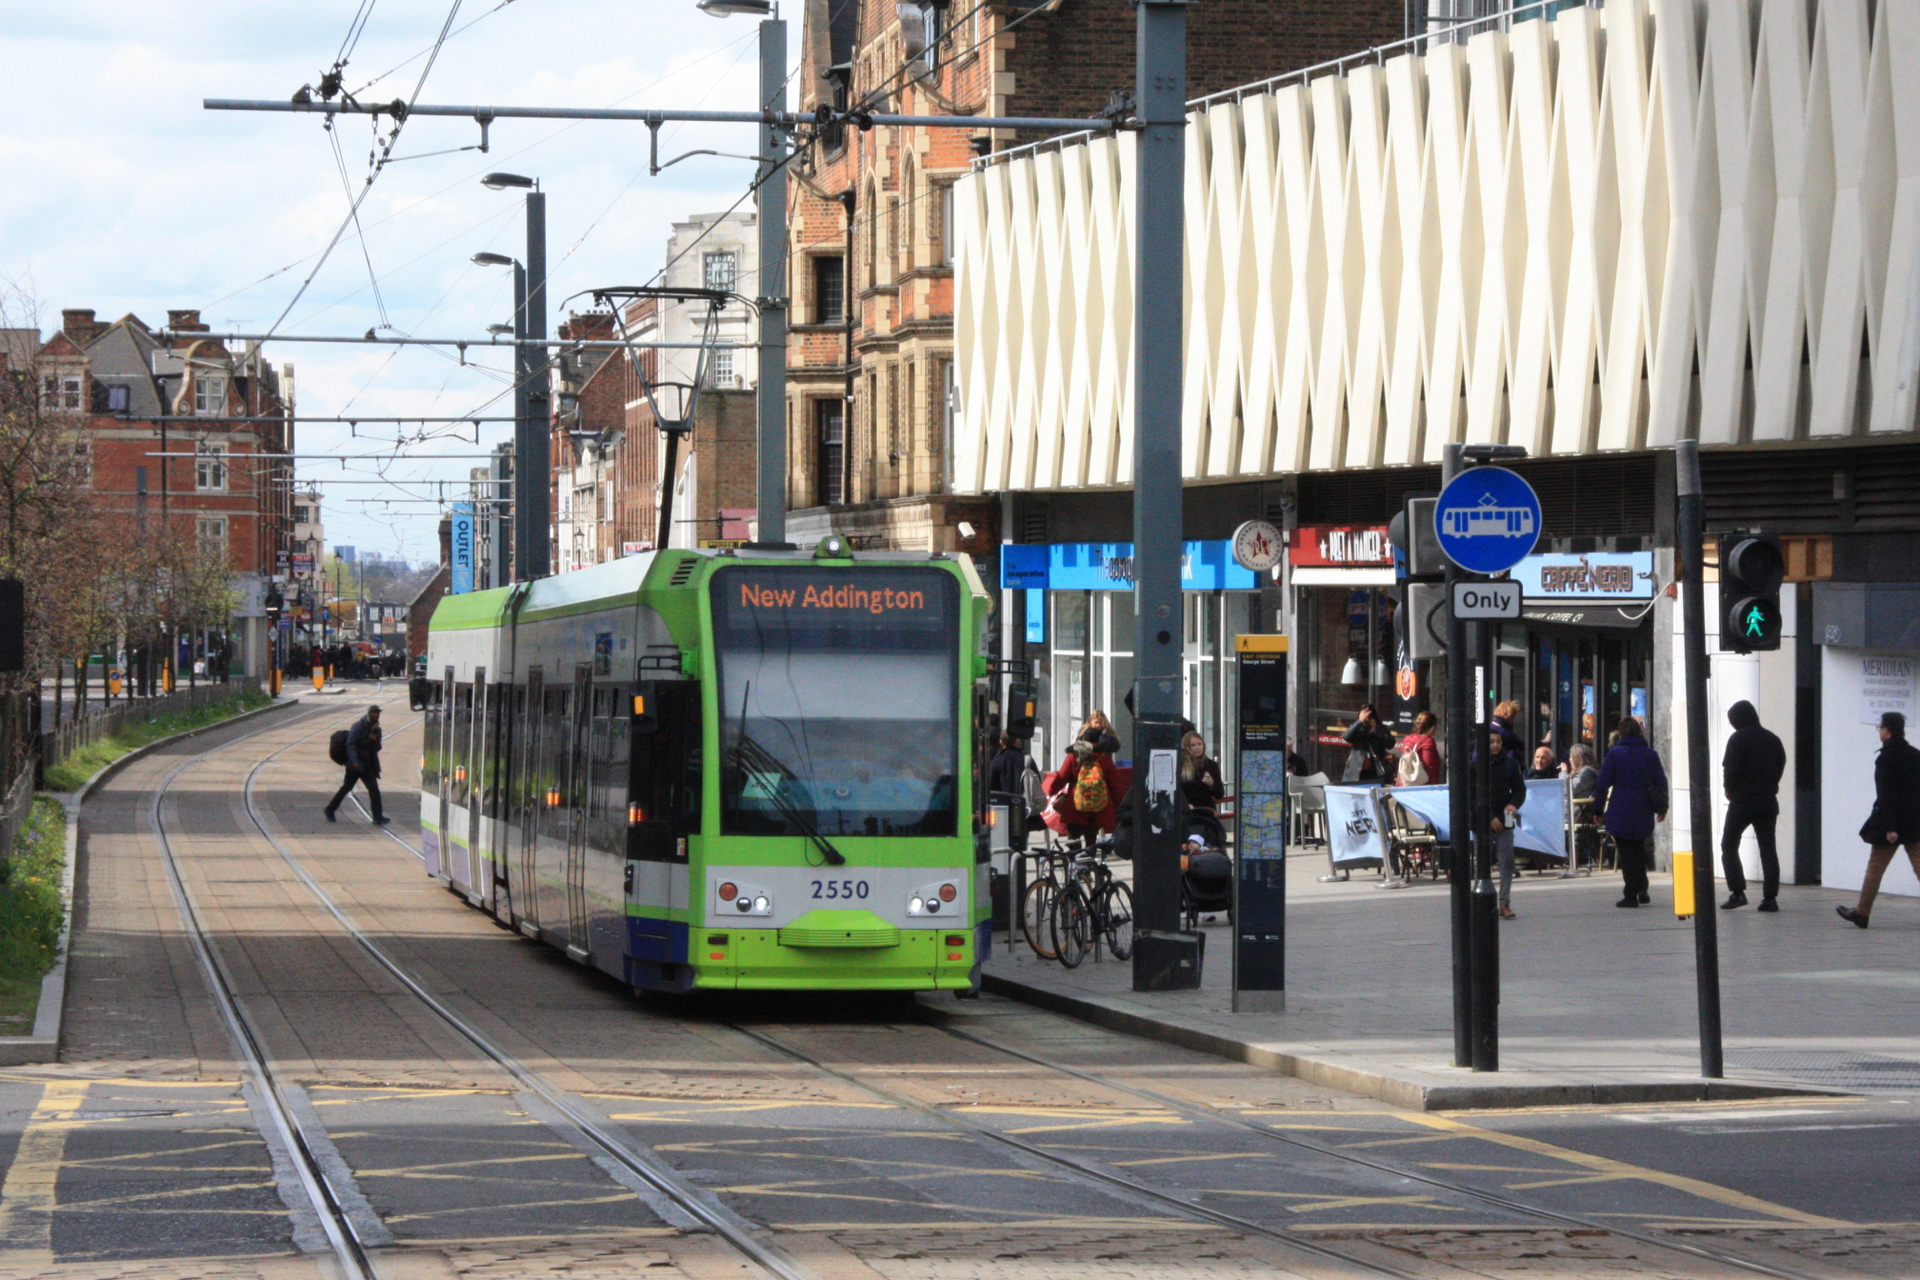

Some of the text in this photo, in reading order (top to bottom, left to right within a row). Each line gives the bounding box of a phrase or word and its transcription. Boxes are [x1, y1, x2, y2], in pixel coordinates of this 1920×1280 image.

[458, 520, 469, 568] OUTLET
[1008, 570, 1045, 578] co-operative
[1587, 564, 1633, 593] NERO
[741, 584, 924, 614] New Addington
[1463, 591, 1511, 611] Only
[1862, 660, 1911, 677] MERIDIAN
[811, 880, 870, 899] 2550
